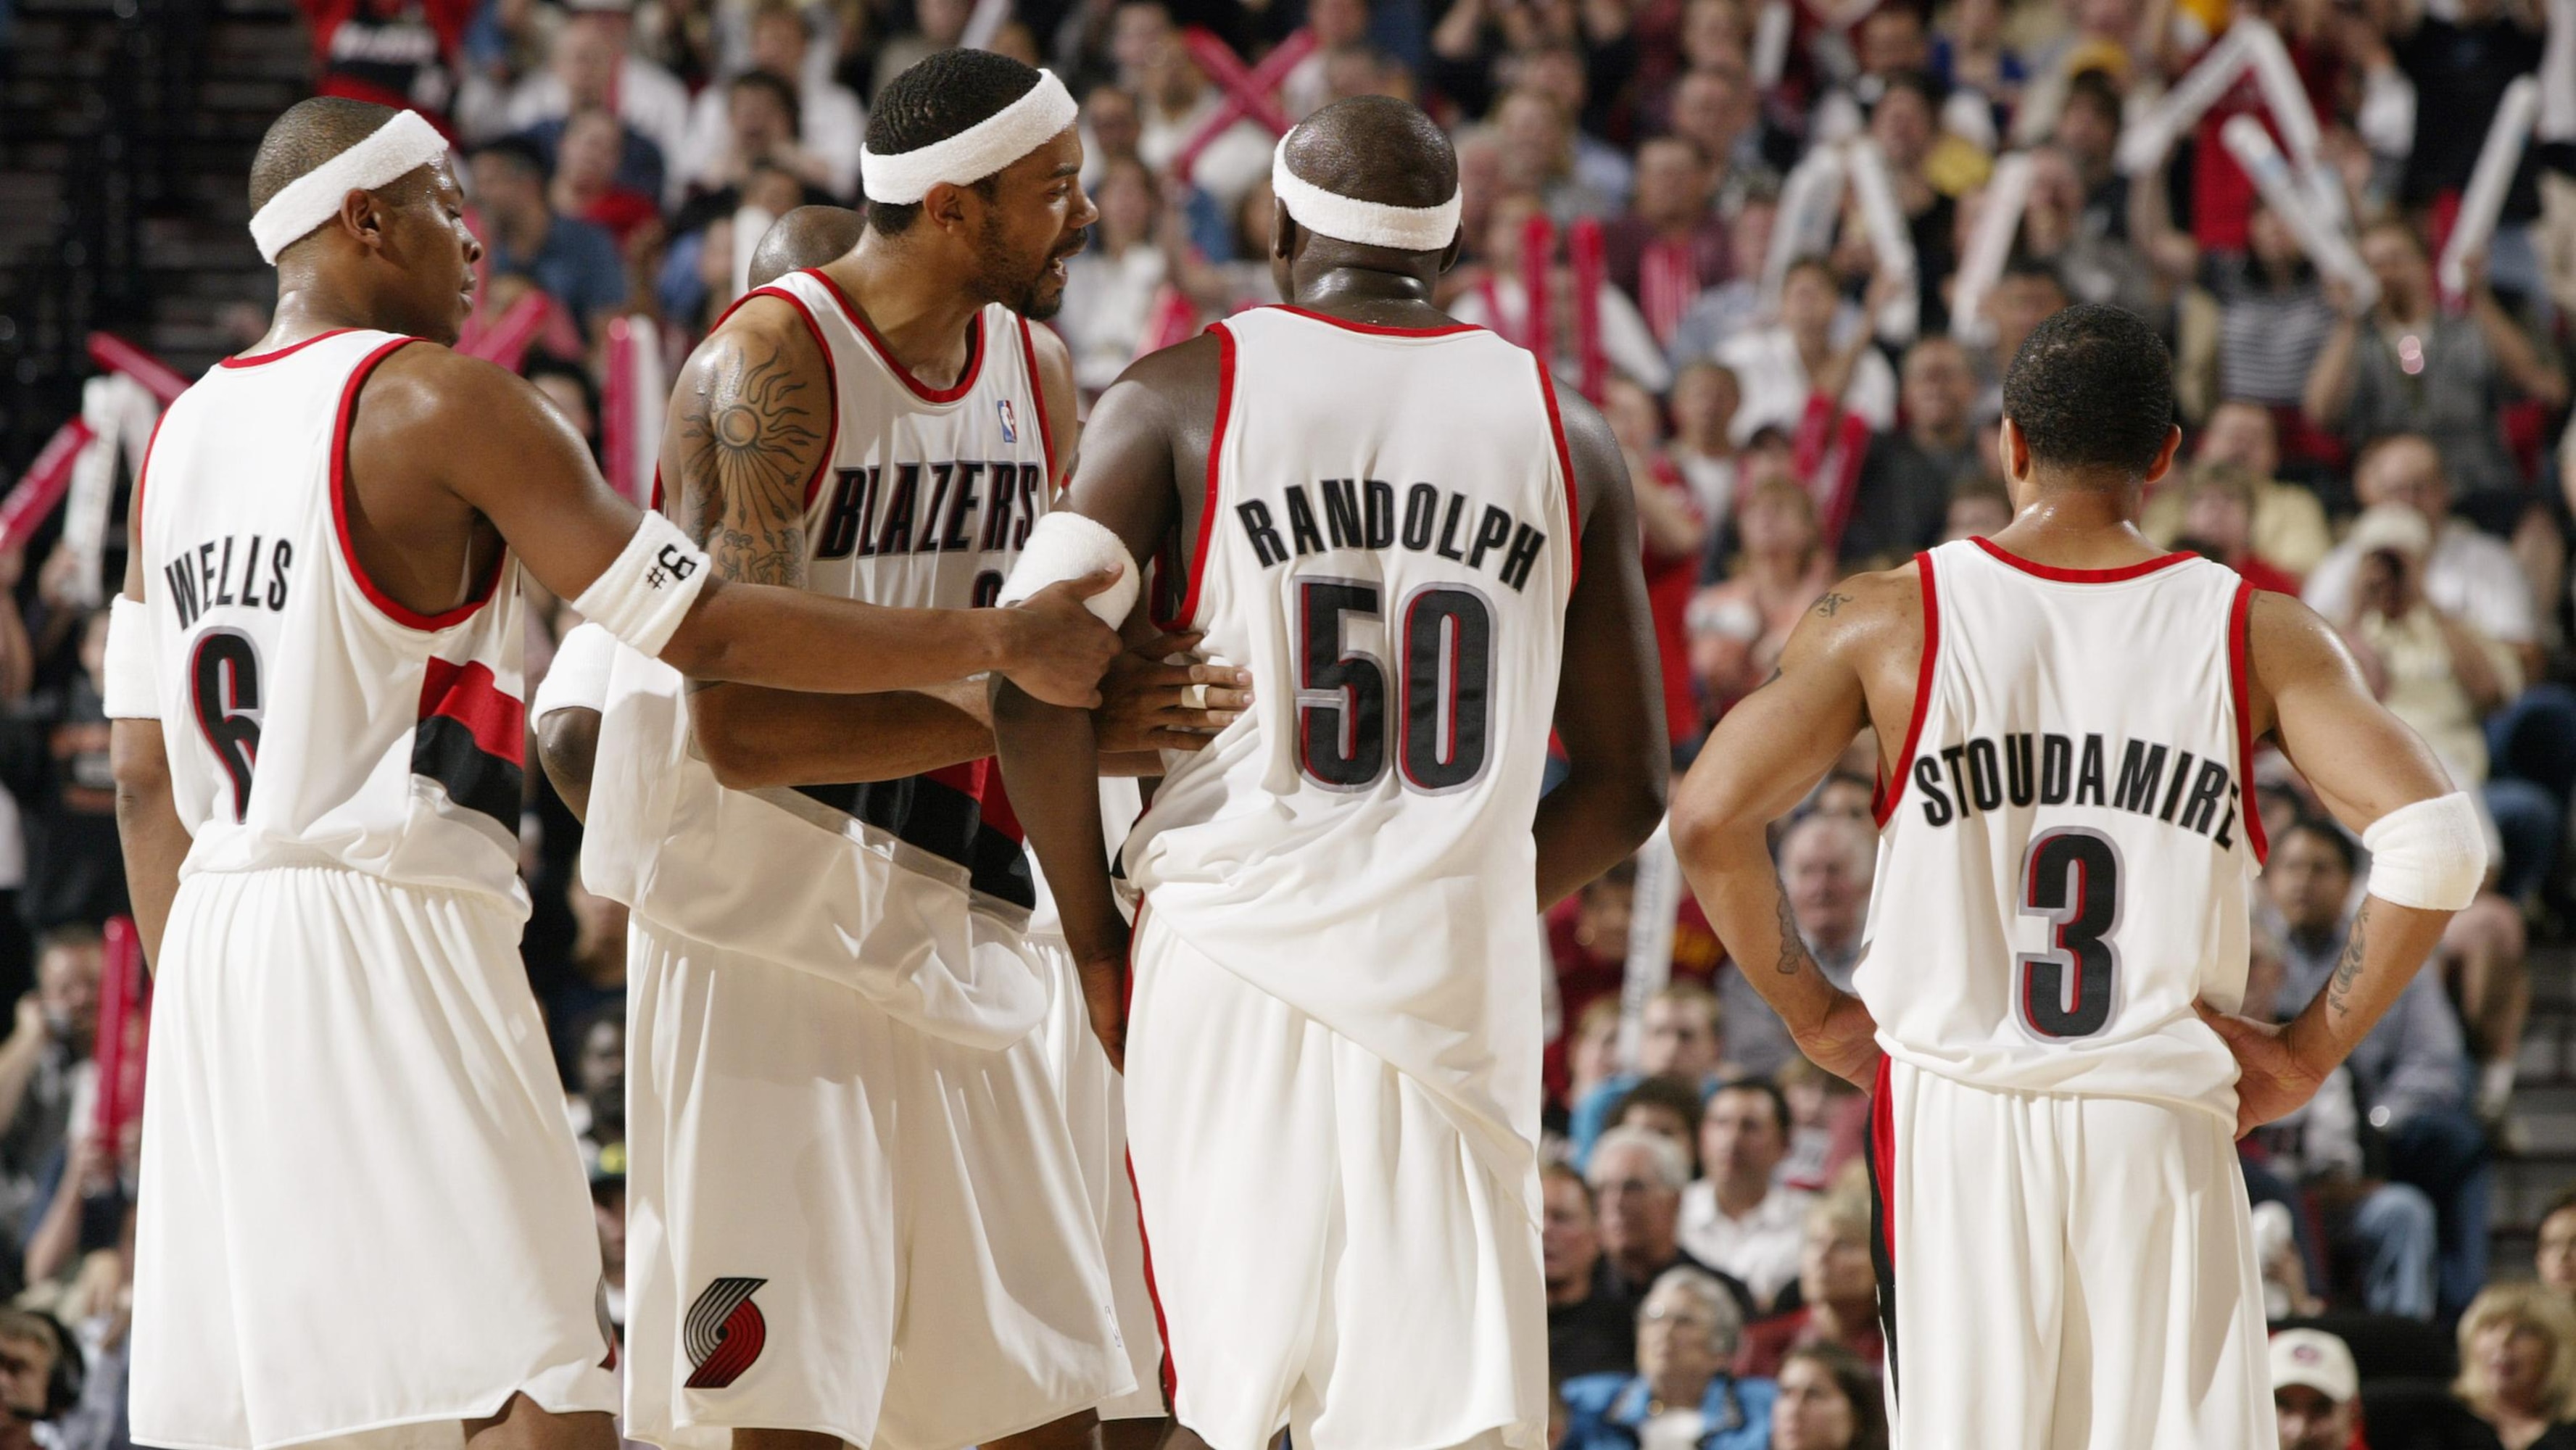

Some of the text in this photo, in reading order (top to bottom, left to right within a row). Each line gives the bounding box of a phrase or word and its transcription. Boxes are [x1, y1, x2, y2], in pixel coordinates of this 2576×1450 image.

[813, 460, 1040, 560] BLAZERS
[1235, 478, 1546, 594] RANDOLPH
[165, 534, 292, 631] WELLS
[186, 625, 264, 826] 6
[1293, 575, 1499, 797] 50
[1914, 733, 2240, 852] STOUDAMIRE
[2014, 825, 2126, 1045] 3
